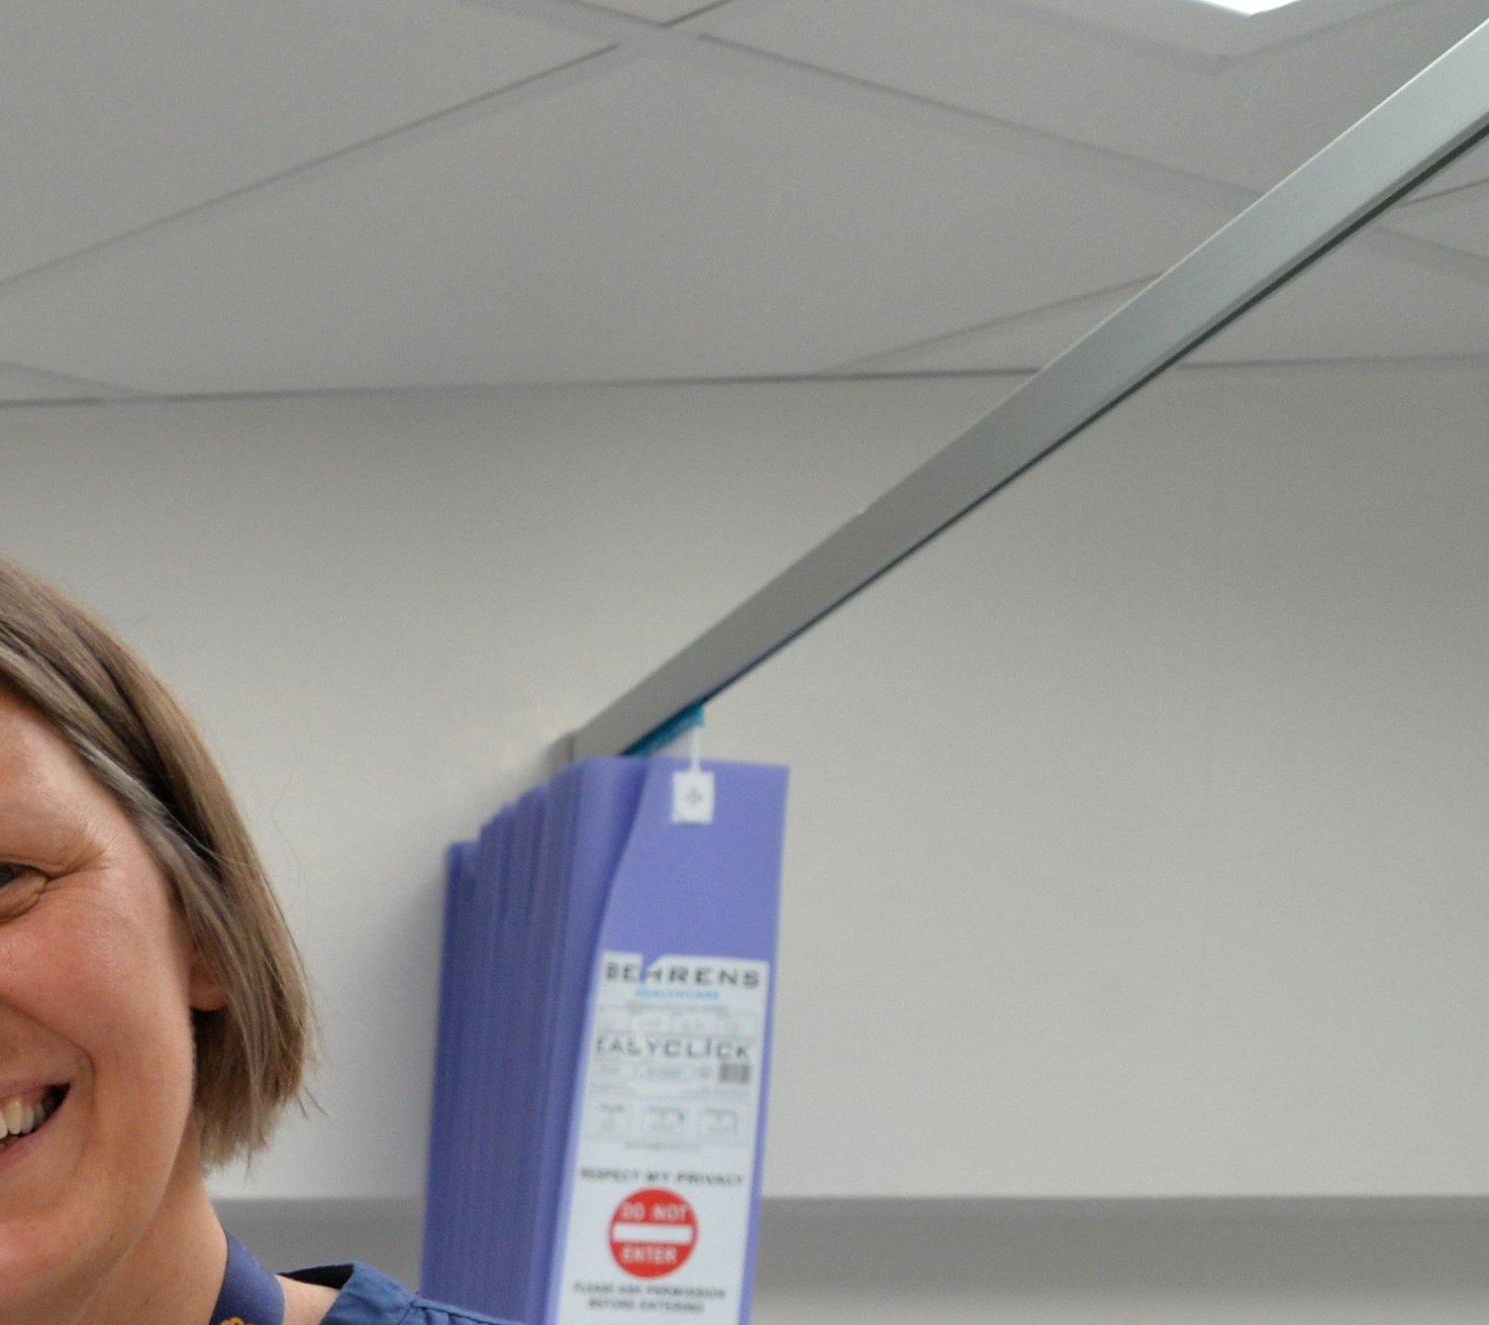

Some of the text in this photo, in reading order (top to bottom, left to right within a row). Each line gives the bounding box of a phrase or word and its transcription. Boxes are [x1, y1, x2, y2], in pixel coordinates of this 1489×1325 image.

[622, 1203, 687, 1222] DO NOT
[622, 1245, 677, 1264] ENTER
